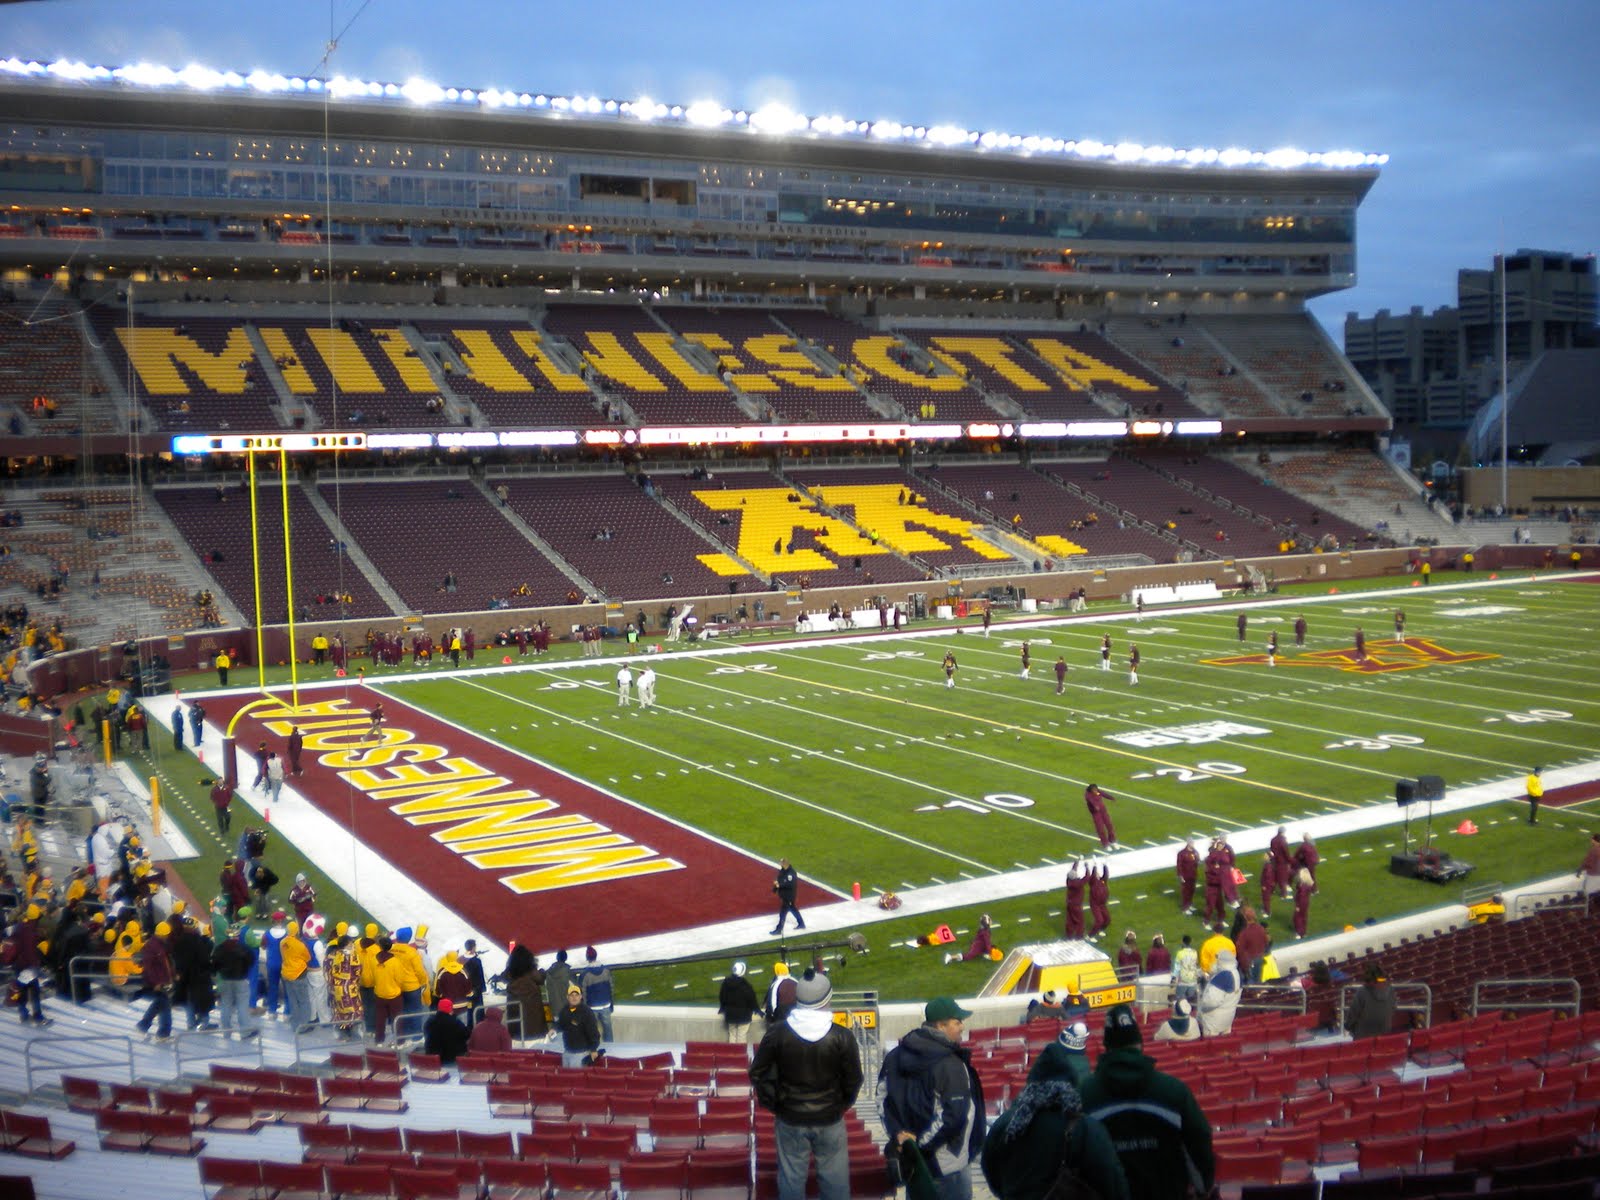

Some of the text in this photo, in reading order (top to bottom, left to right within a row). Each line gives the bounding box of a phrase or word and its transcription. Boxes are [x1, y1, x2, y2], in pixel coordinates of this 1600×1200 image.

[114, 326, 1159, 395] MINNESOTA
[1342, 733, 1426, 751] 30
[1155, 761, 1248, 783] 20
[249, 699, 687, 894] MINNESOTA
[942, 793, 1036, 814] 10
[1116, 989, 1133, 1001] 114
